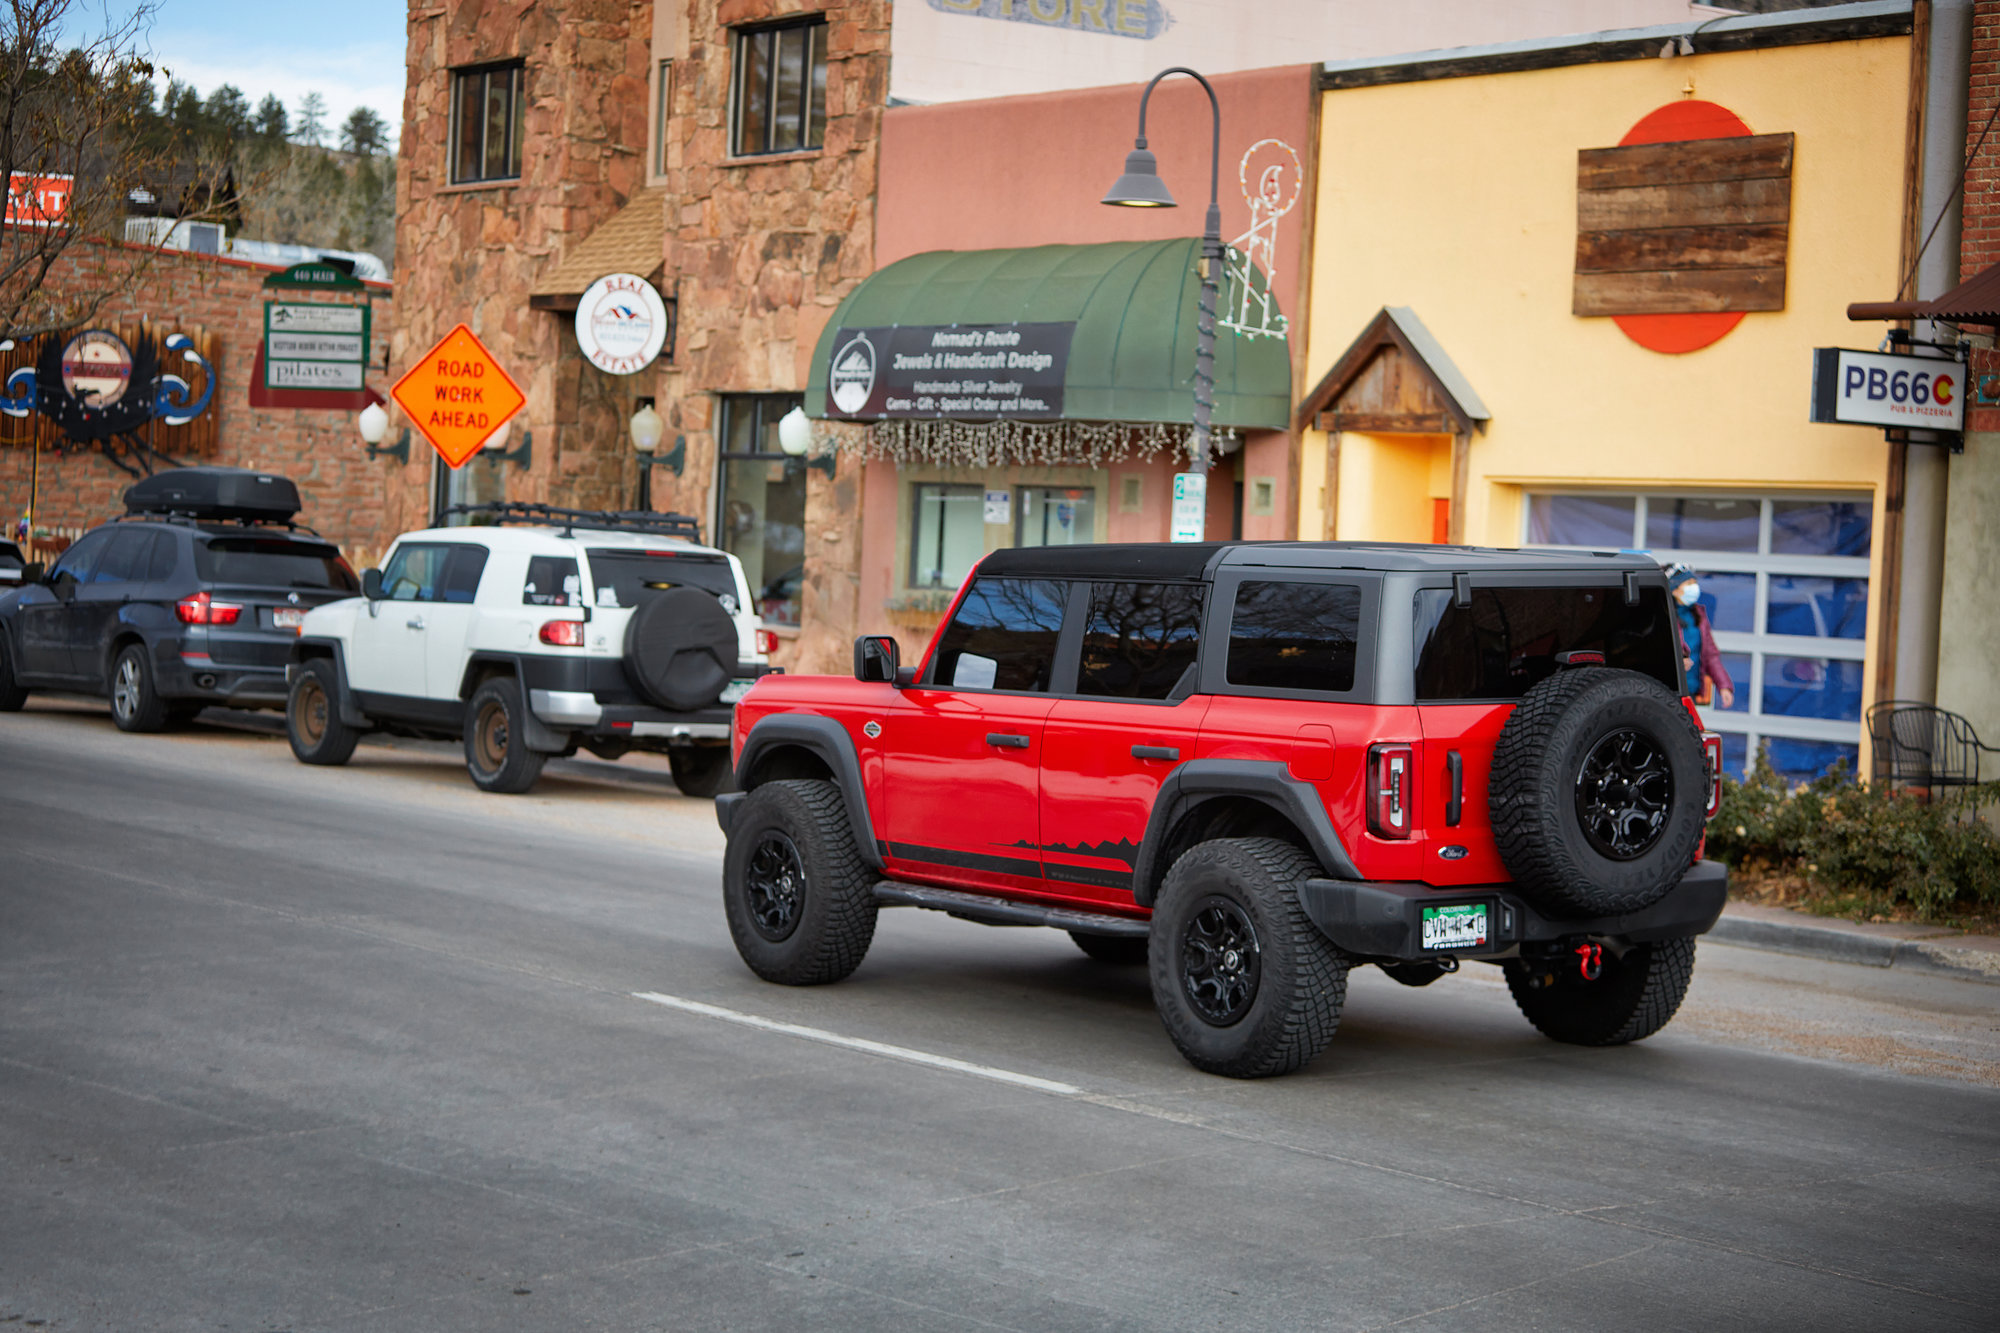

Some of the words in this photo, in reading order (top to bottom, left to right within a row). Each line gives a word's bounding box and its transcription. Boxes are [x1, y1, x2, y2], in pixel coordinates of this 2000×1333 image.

[312, 271, 337, 282] MAIN
[605, 277, 645, 296] REAL
[931, 331, 982, 347] Nomad's
[984, 330, 1021, 347] Route
[437, 359, 485, 378] ROAD
[592, 348, 648, 371] ESTATE
[893, 353, 933, 370] Jewels
[934, 353, 942, 369] &
[943, 351, 1007, 369] Handicraft
[1008, 351, 1053, 371] Design
[276, 361, 343, 383] pilates
[434, 384, 484, 404] WORK
[913, 381, 961, 394] Handmade
[962, 380, 987, 394] Silver
[988, 380, 1023, 396] Jewelry
[886, 397, 912, 411] Gems
[916, 397, 935, 411] Gift
[940, 396, 971, 412] Special
[972, 396, 999, 411] Order
[1000, 396, 1019, 411] and
[1890, 404, 1907, 414] PUB
[1908, 405, 1914, 415] &
[1915, 406, 1953, 418] PIZZERIA
[428, 410, 489, 429] AHEAD
